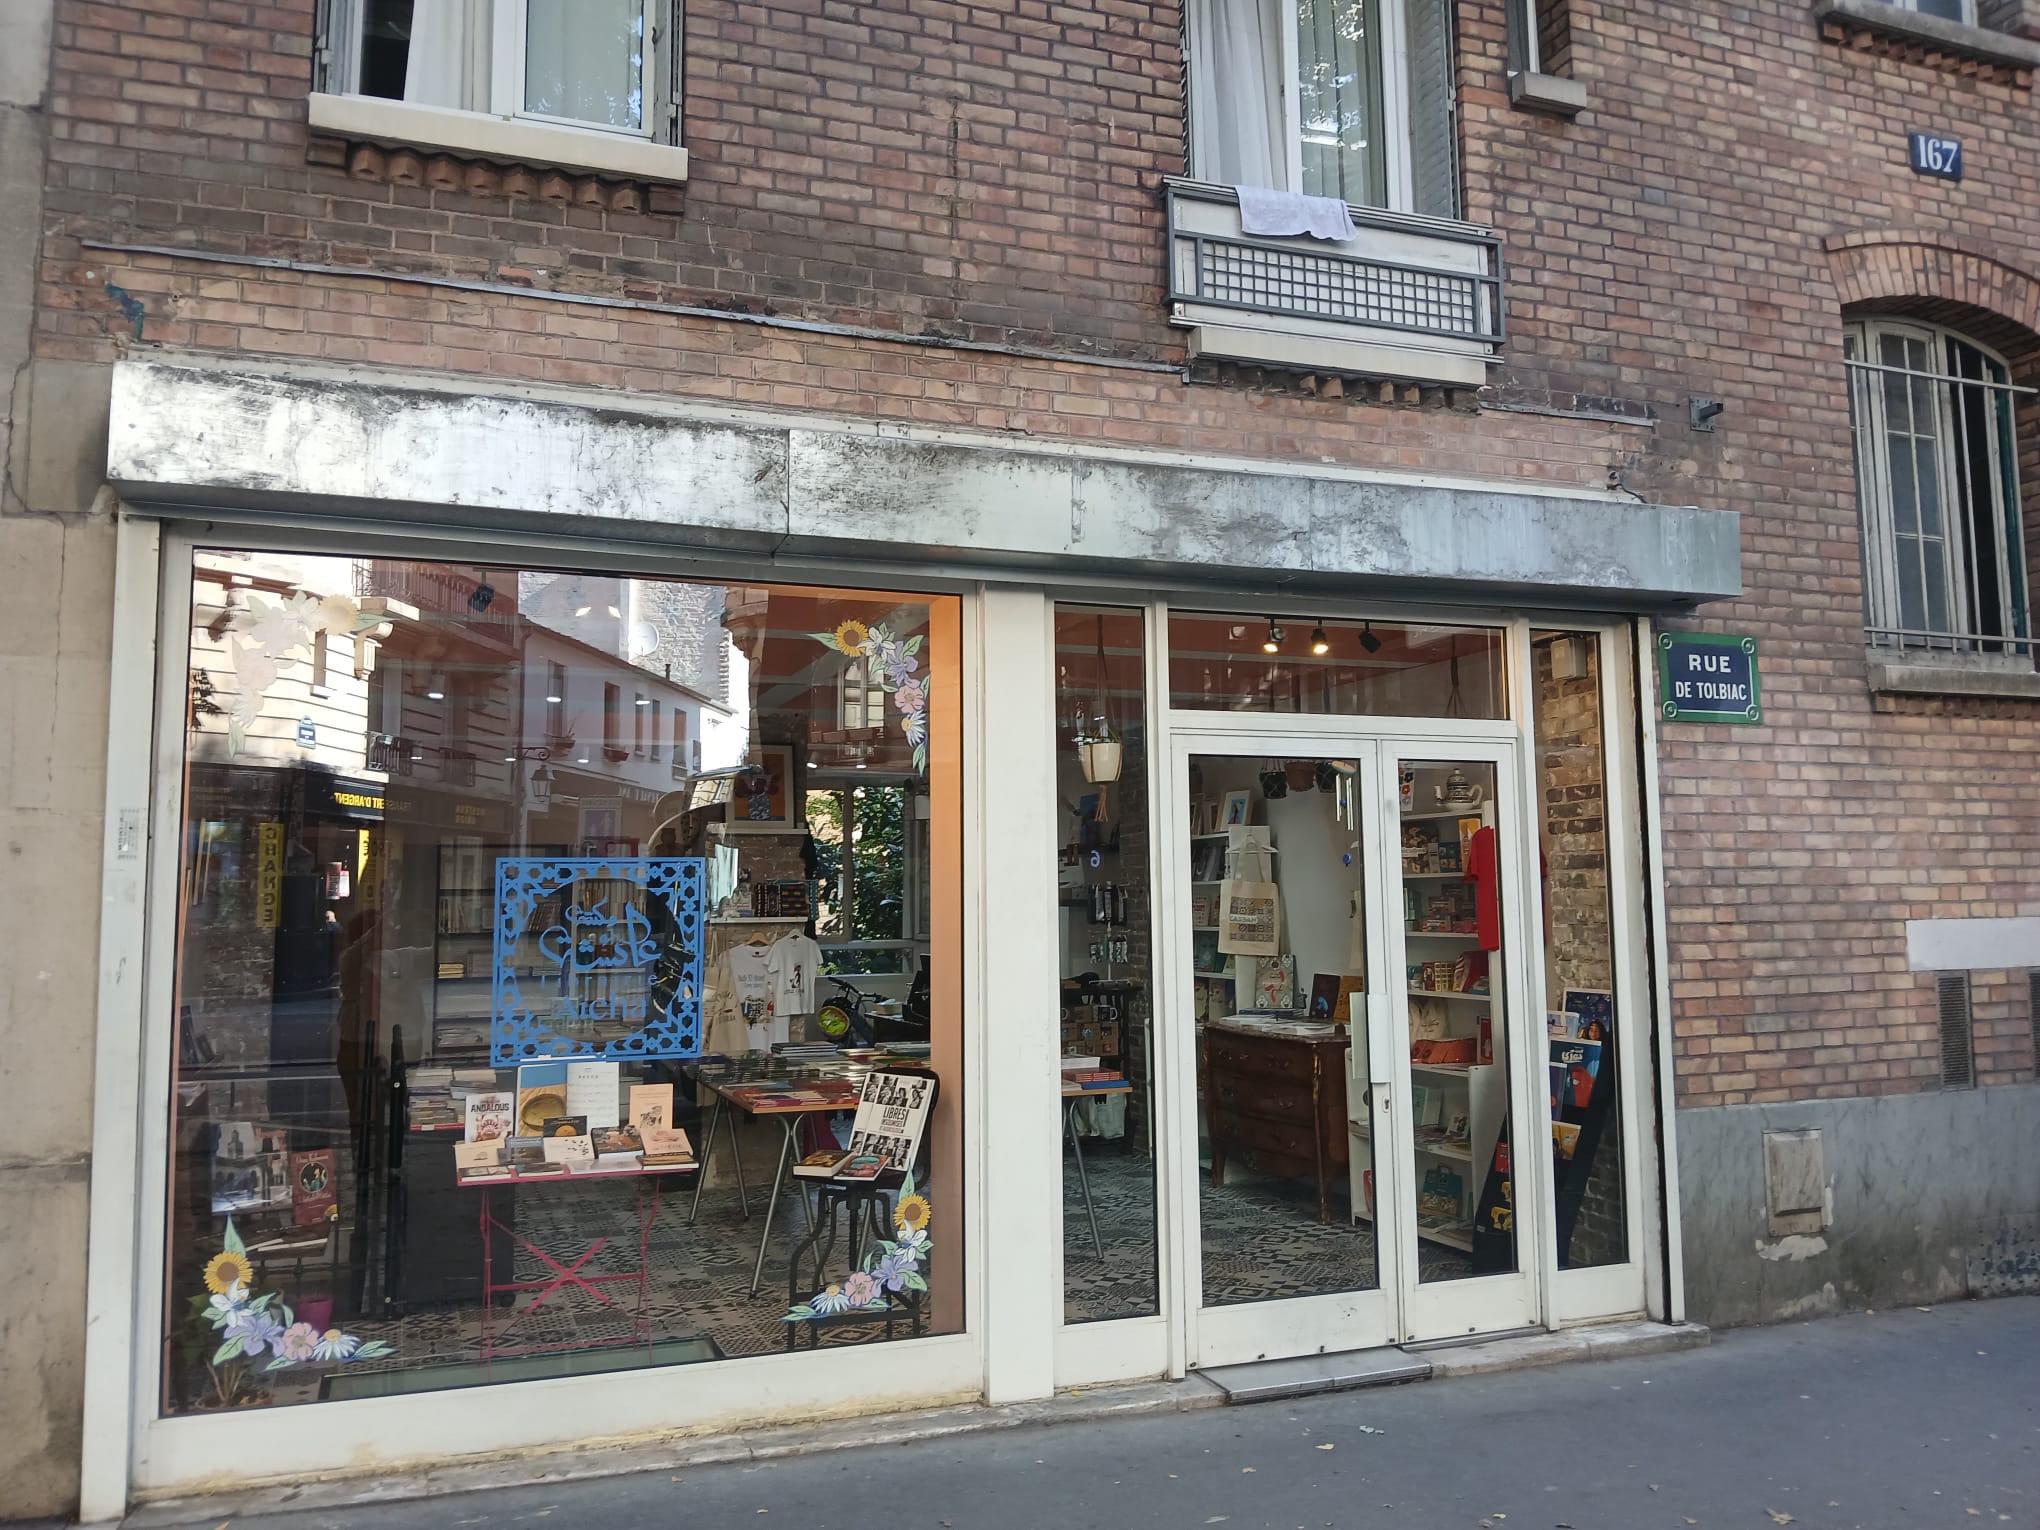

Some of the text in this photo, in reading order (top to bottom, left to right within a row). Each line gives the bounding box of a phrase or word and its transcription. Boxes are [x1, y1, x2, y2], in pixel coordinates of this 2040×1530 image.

[1918, 135, 1958, 173] 167
[1688, 654, 1732, 673] RUE
[1675, 681, 1747, 701] DE TOLBIAC
[471, 1103, 510, 1113] ANDALOUS
[883, 1106, 907, 1120] LIBRES
